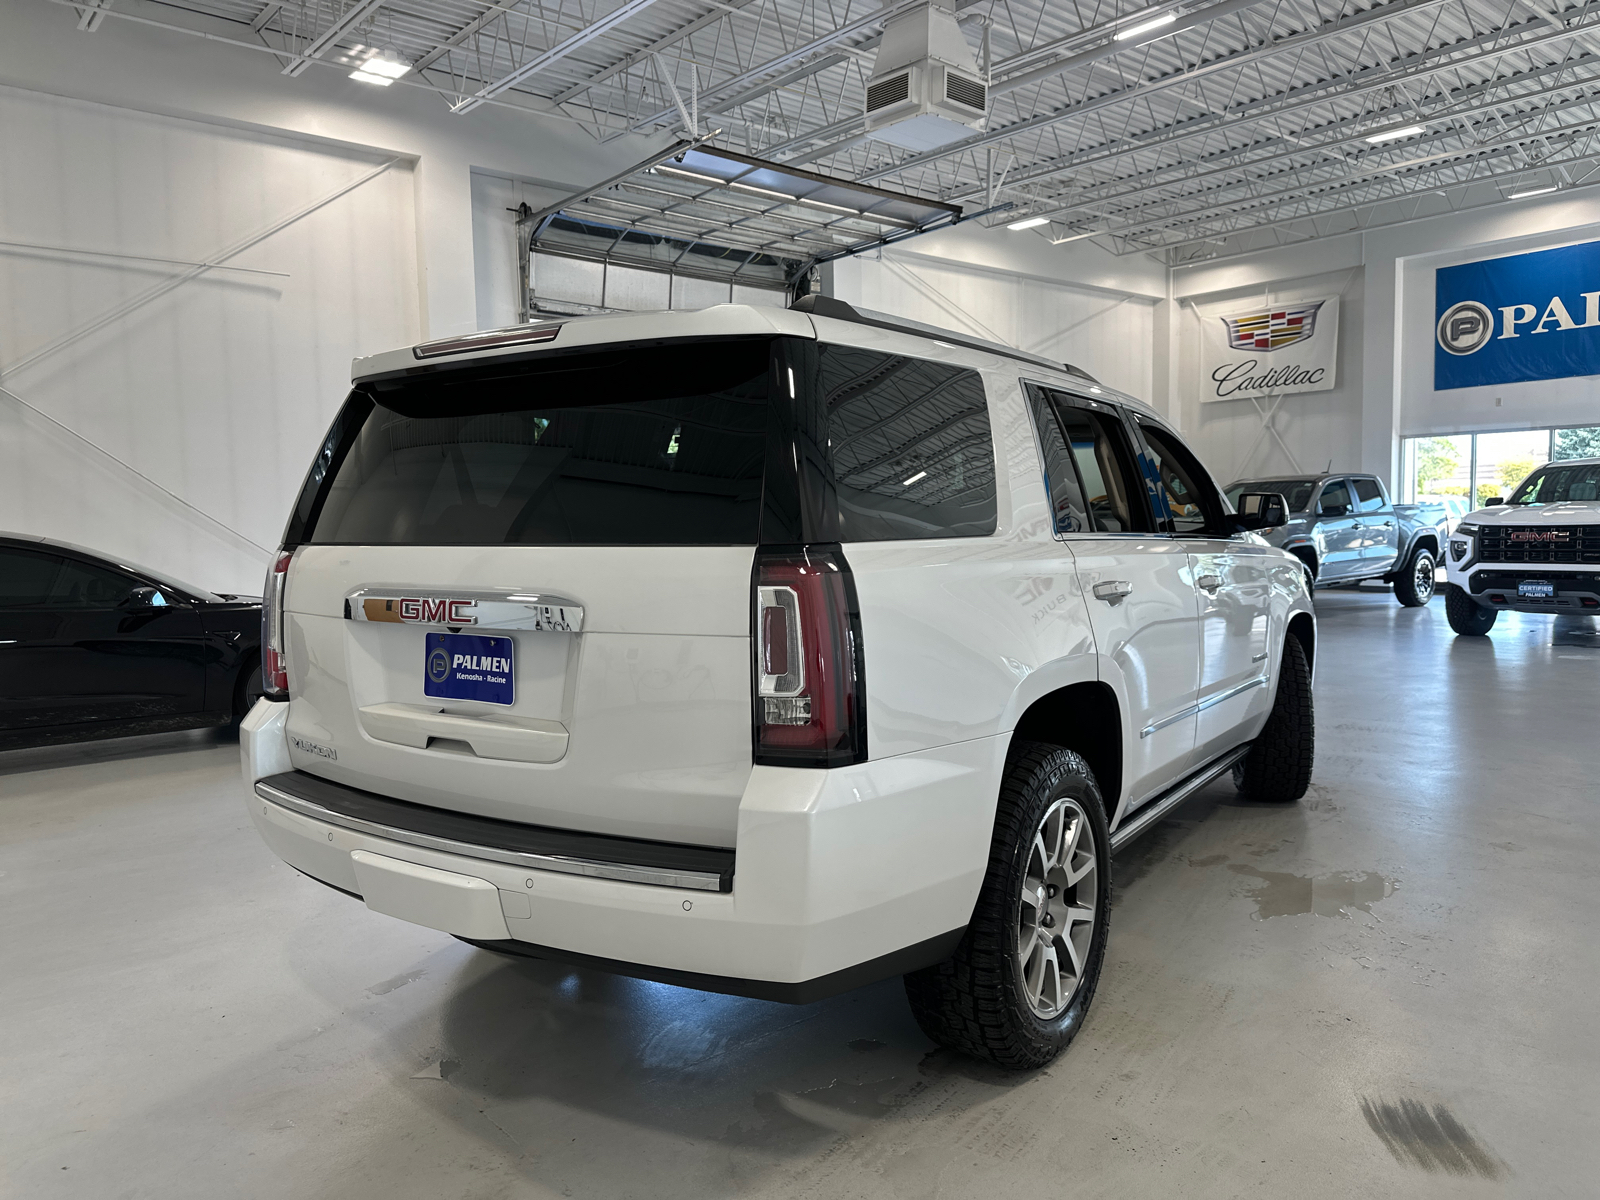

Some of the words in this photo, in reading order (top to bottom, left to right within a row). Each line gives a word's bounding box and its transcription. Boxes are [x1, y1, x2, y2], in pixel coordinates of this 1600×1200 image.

[1211, 359, 1325, 397] Cadillac
[1511, 531, 1570, 542] GMC
[399, 597, 478, 625] GMC
[452, 654, 510, 673] PALMEN
[456, 672, 482, 681] Kenosha
[487, 675, 506, 684] Racine
